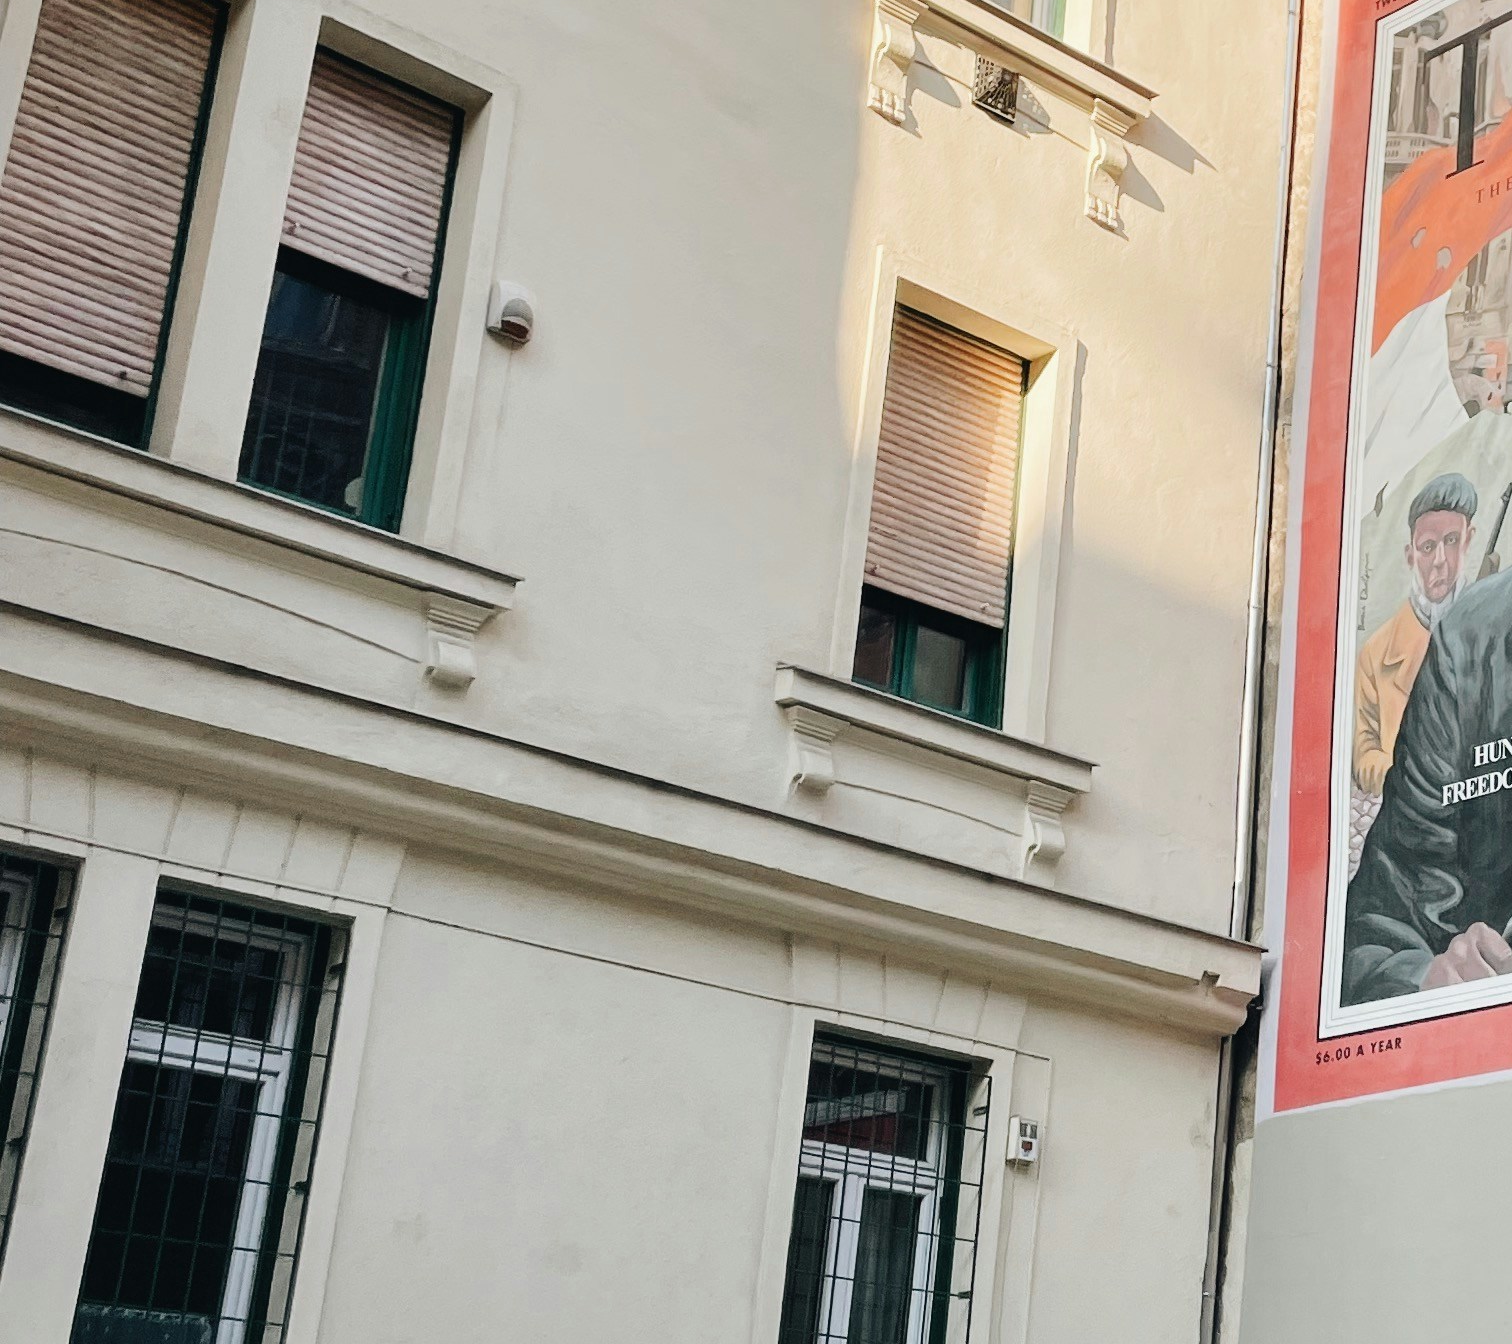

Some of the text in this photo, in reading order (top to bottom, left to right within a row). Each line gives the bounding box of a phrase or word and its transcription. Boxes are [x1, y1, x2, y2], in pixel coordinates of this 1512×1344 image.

[1315, 1037, 1402, 1065] $6.00 A YEAR
